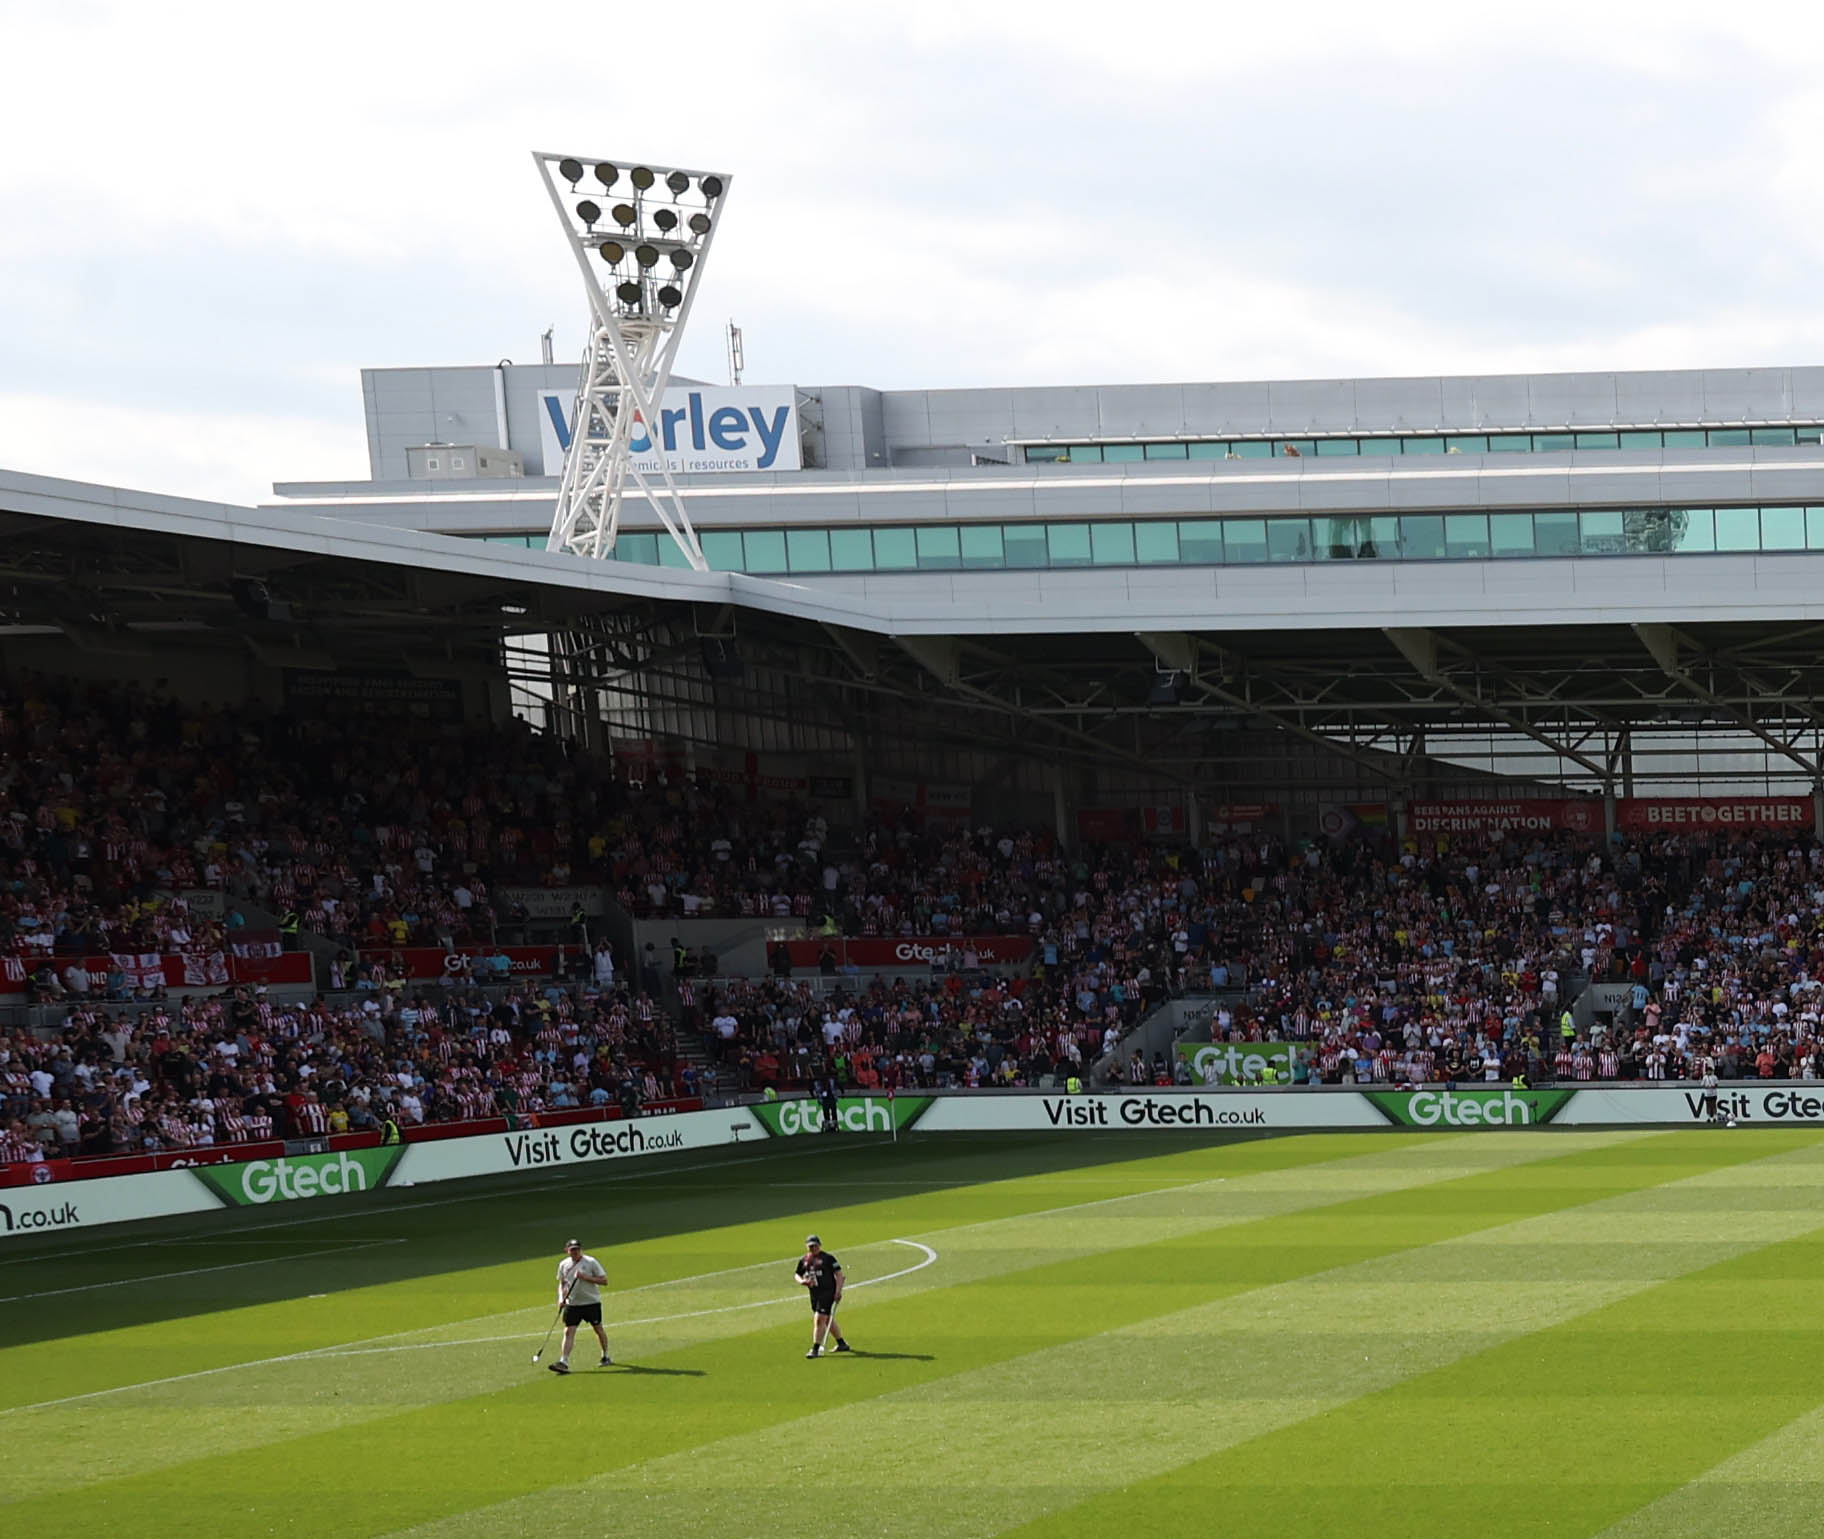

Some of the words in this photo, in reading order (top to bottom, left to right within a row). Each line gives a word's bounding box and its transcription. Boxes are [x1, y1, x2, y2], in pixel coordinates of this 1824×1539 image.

[689, 459, 749, 471] resources
[1414, 806, 1440, 815] BEES
[1442, 806, 1471, 815] FANS
[1472, 805, 1521, 814] AGAINST
[1043, 1099, 1108, 1125] Visit
[1121, 1098, 1265, 1126] Gtech.co.uk
[1408, 1090, 1529, 1126] Gtech
[1685, 1091, 1751, 1119] Vsit
[505, 1132, 561, 1166] Visit
[570, 1124, 684, 1159] Gtech.co.uk
[241, 1151, 366, 1203] Gtech
